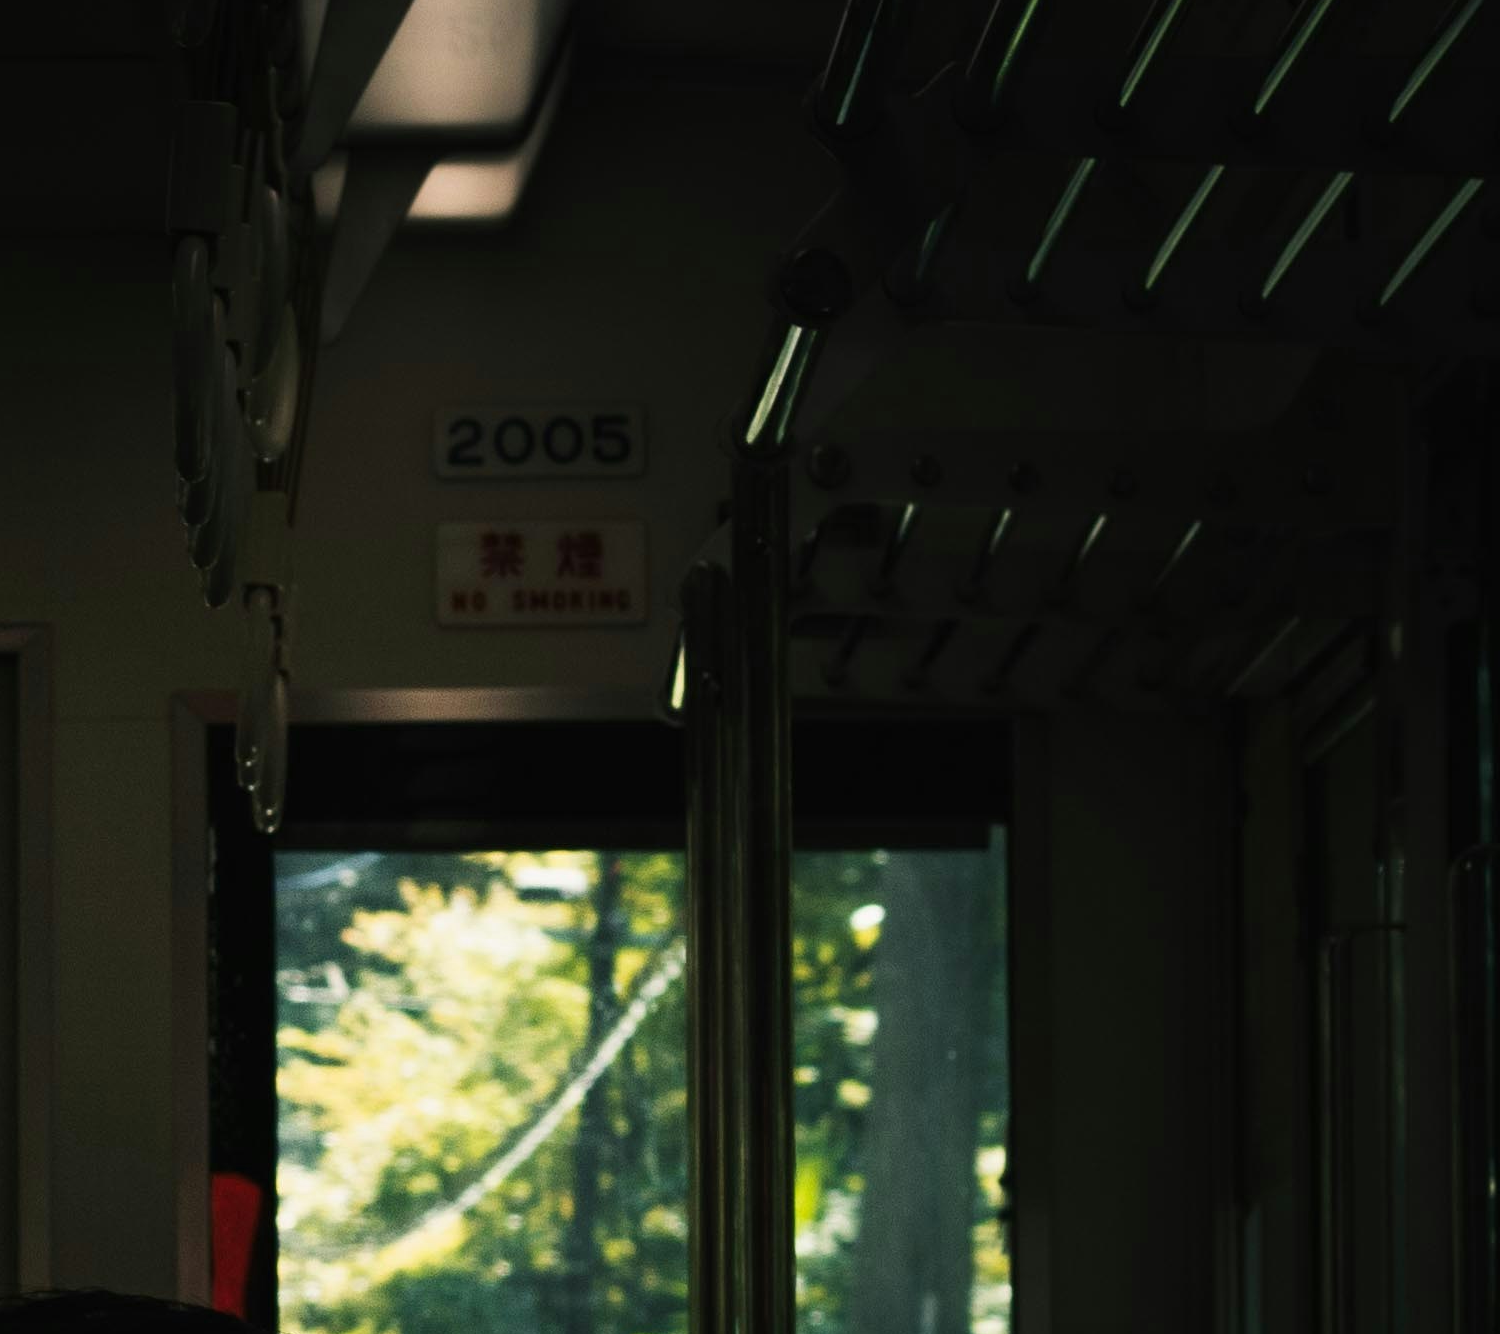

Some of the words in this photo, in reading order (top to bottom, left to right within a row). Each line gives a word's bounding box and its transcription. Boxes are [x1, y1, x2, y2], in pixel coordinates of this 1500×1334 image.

[448, 415, 631, 465] 2005
[481, 532, 602, 578] 禁煙
[451, 589, 486, 612] NO
[512, 588, 631, 611] SMOKING
